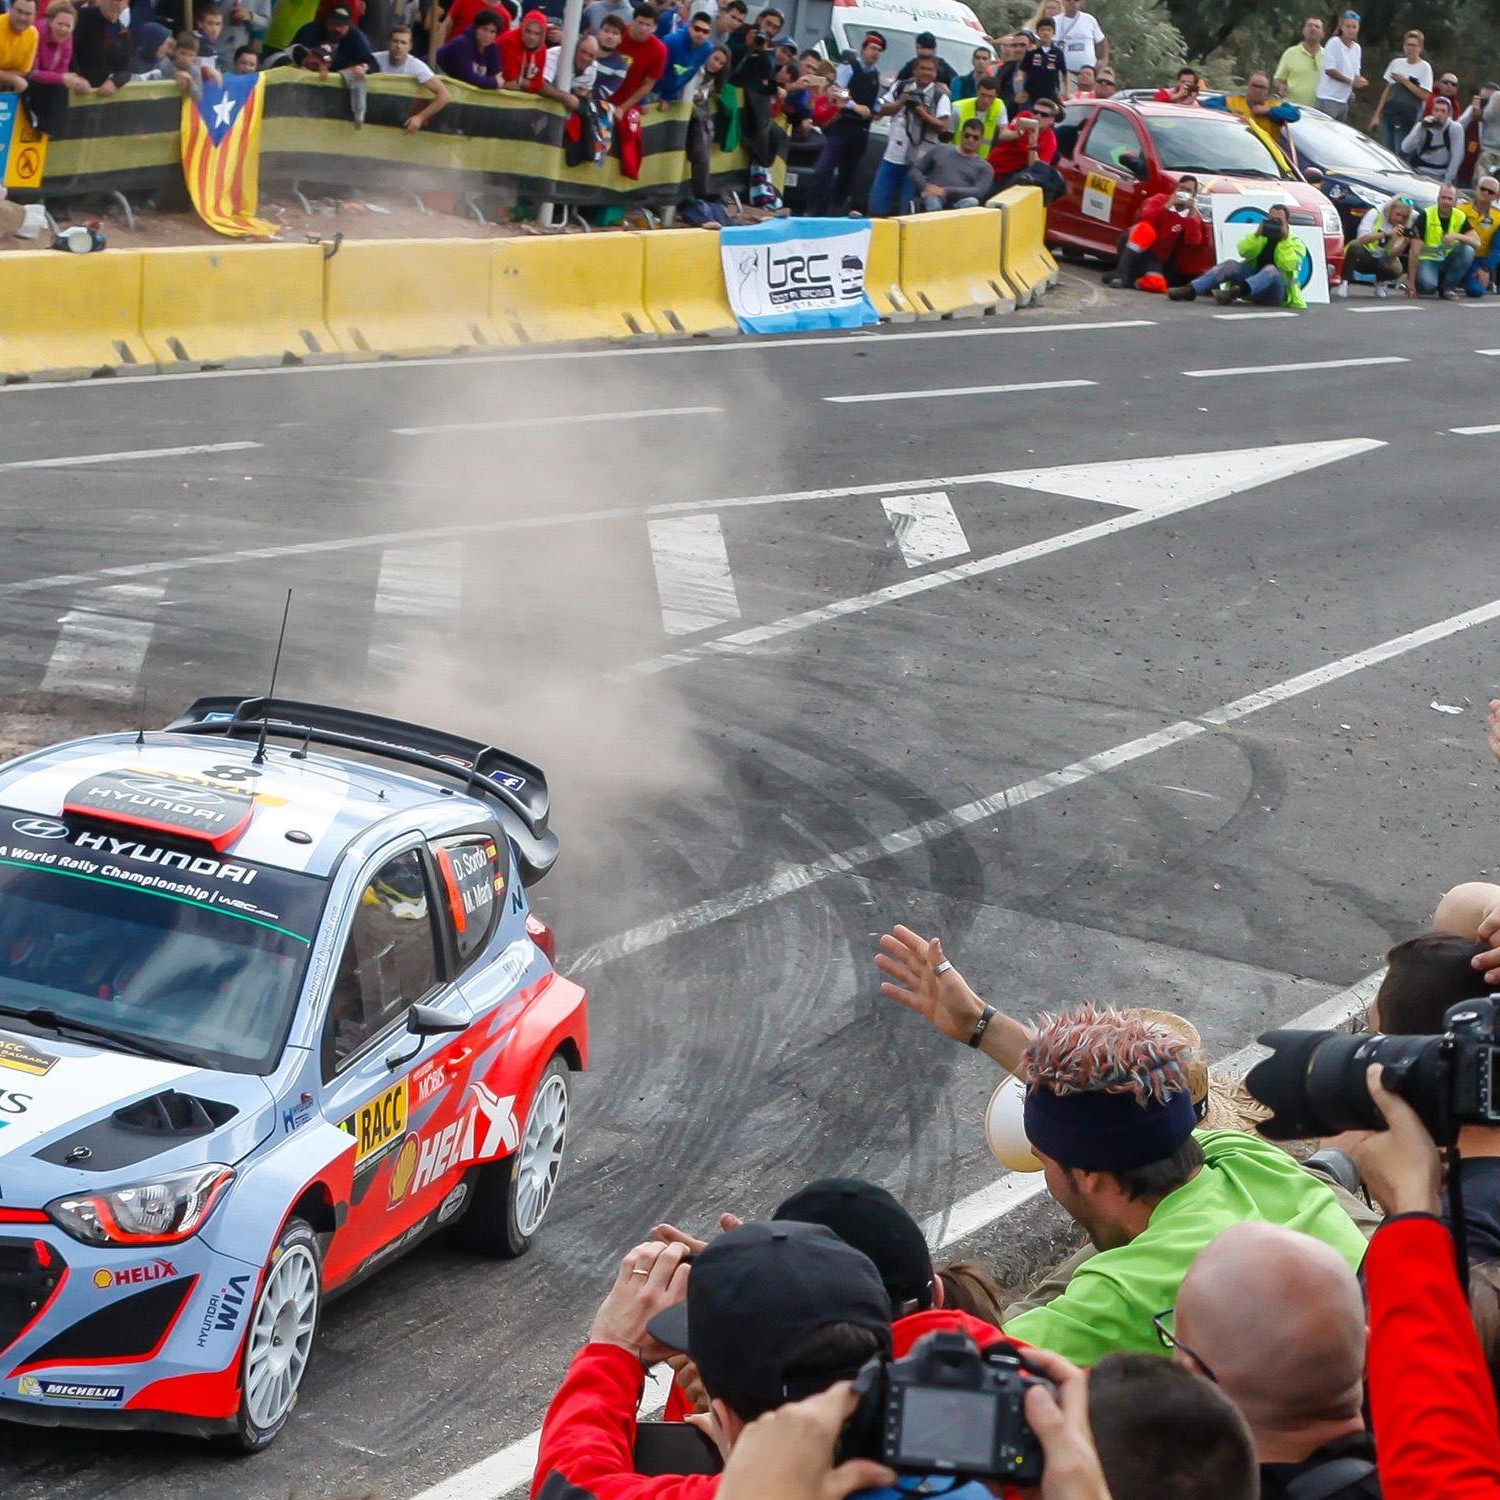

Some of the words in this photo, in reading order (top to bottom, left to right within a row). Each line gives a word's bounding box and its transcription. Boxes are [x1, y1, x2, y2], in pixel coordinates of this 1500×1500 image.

[88, 786, 228, 823] HYUNDAI
[11, 847, 58, 864] World
[58, 856, 99, 874] Rally
[100, 865, 210, 901] Championship
[74, 832, 259, 885] HYUNDAI
[462, 848, 487, 876] Sordo
[361, 1084, 404, 1154] RACC
[411, 1081, 520, 1195] HELIX
[115, 1257, 179, 1287] HELIX
[196, 1293, 220, 1349] HYUNDAI
[45, 1383, 121, 1398] MICHELIN
